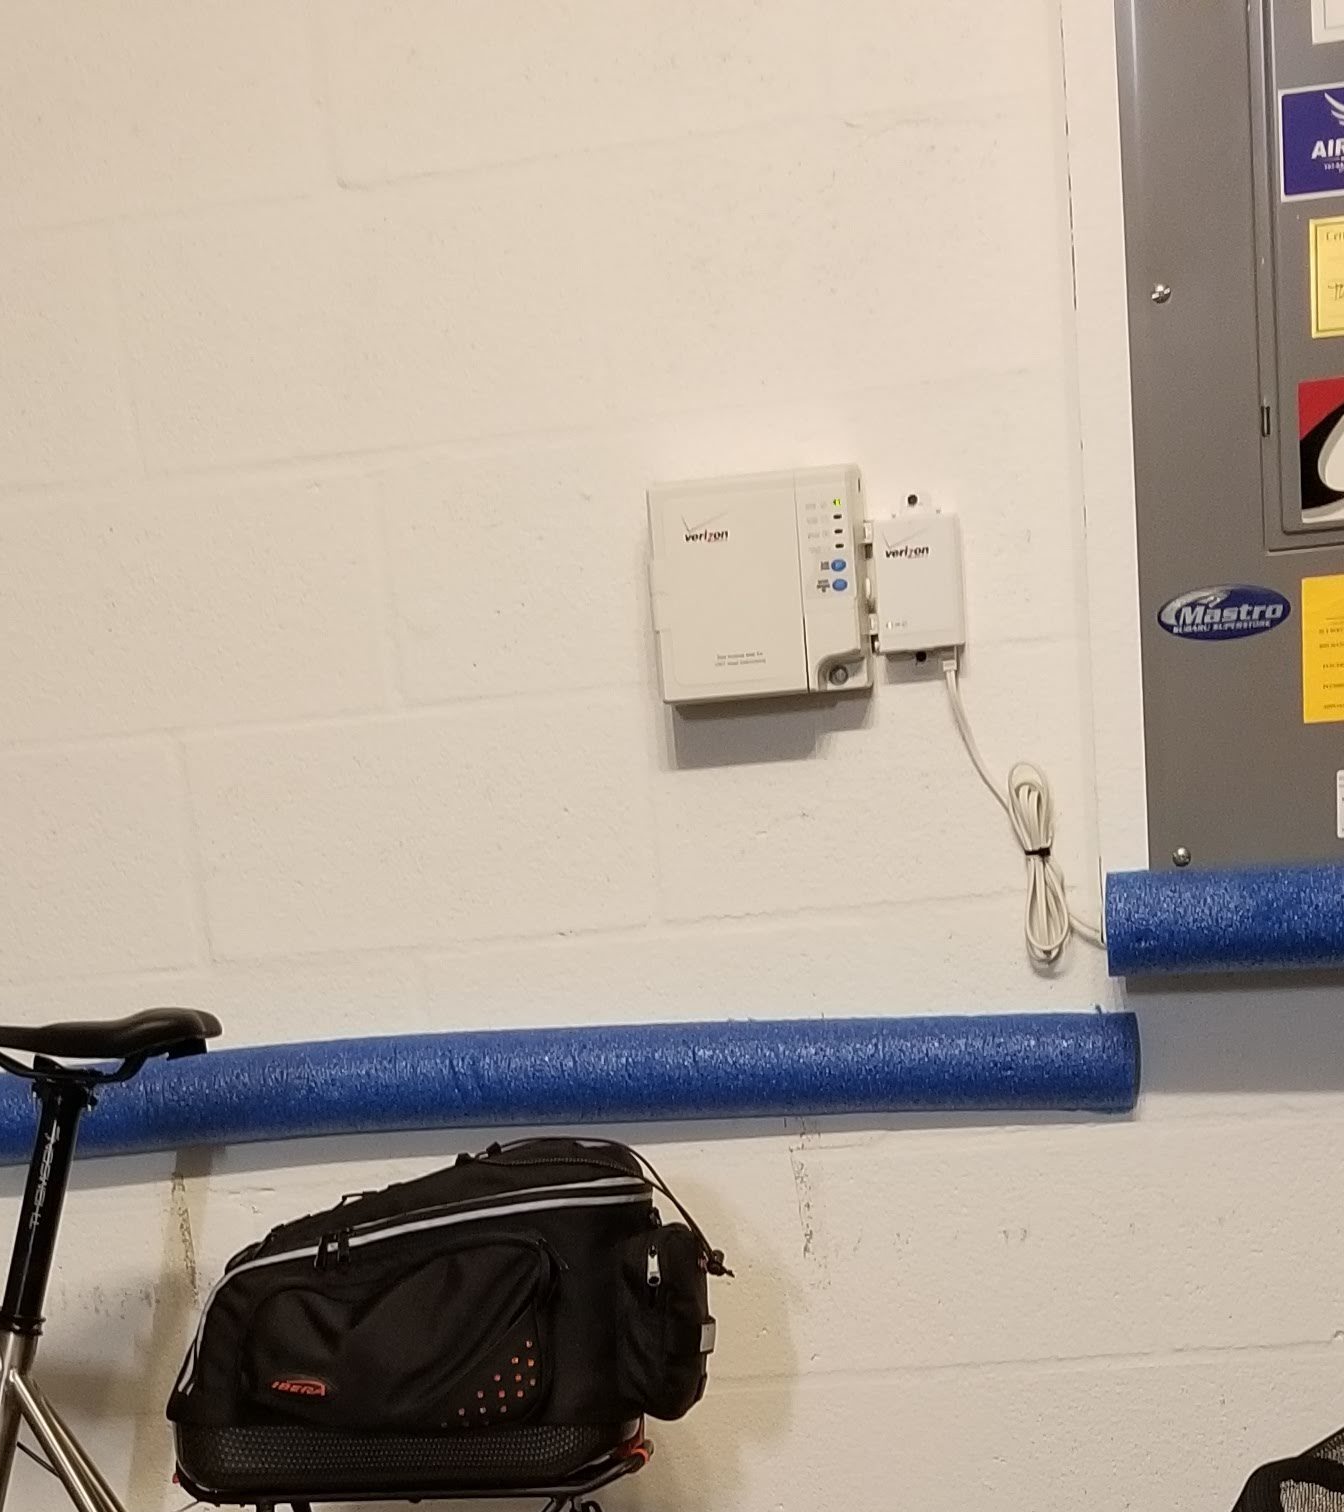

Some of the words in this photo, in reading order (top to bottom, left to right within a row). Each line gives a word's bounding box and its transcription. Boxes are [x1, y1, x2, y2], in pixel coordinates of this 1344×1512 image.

[684, 528, 729, 543] verizon
[884, 544, 929, 559] verizon
[1179, 603, 1284, 625] Mastro
[271, 1380, 326, 1397] IBERA
